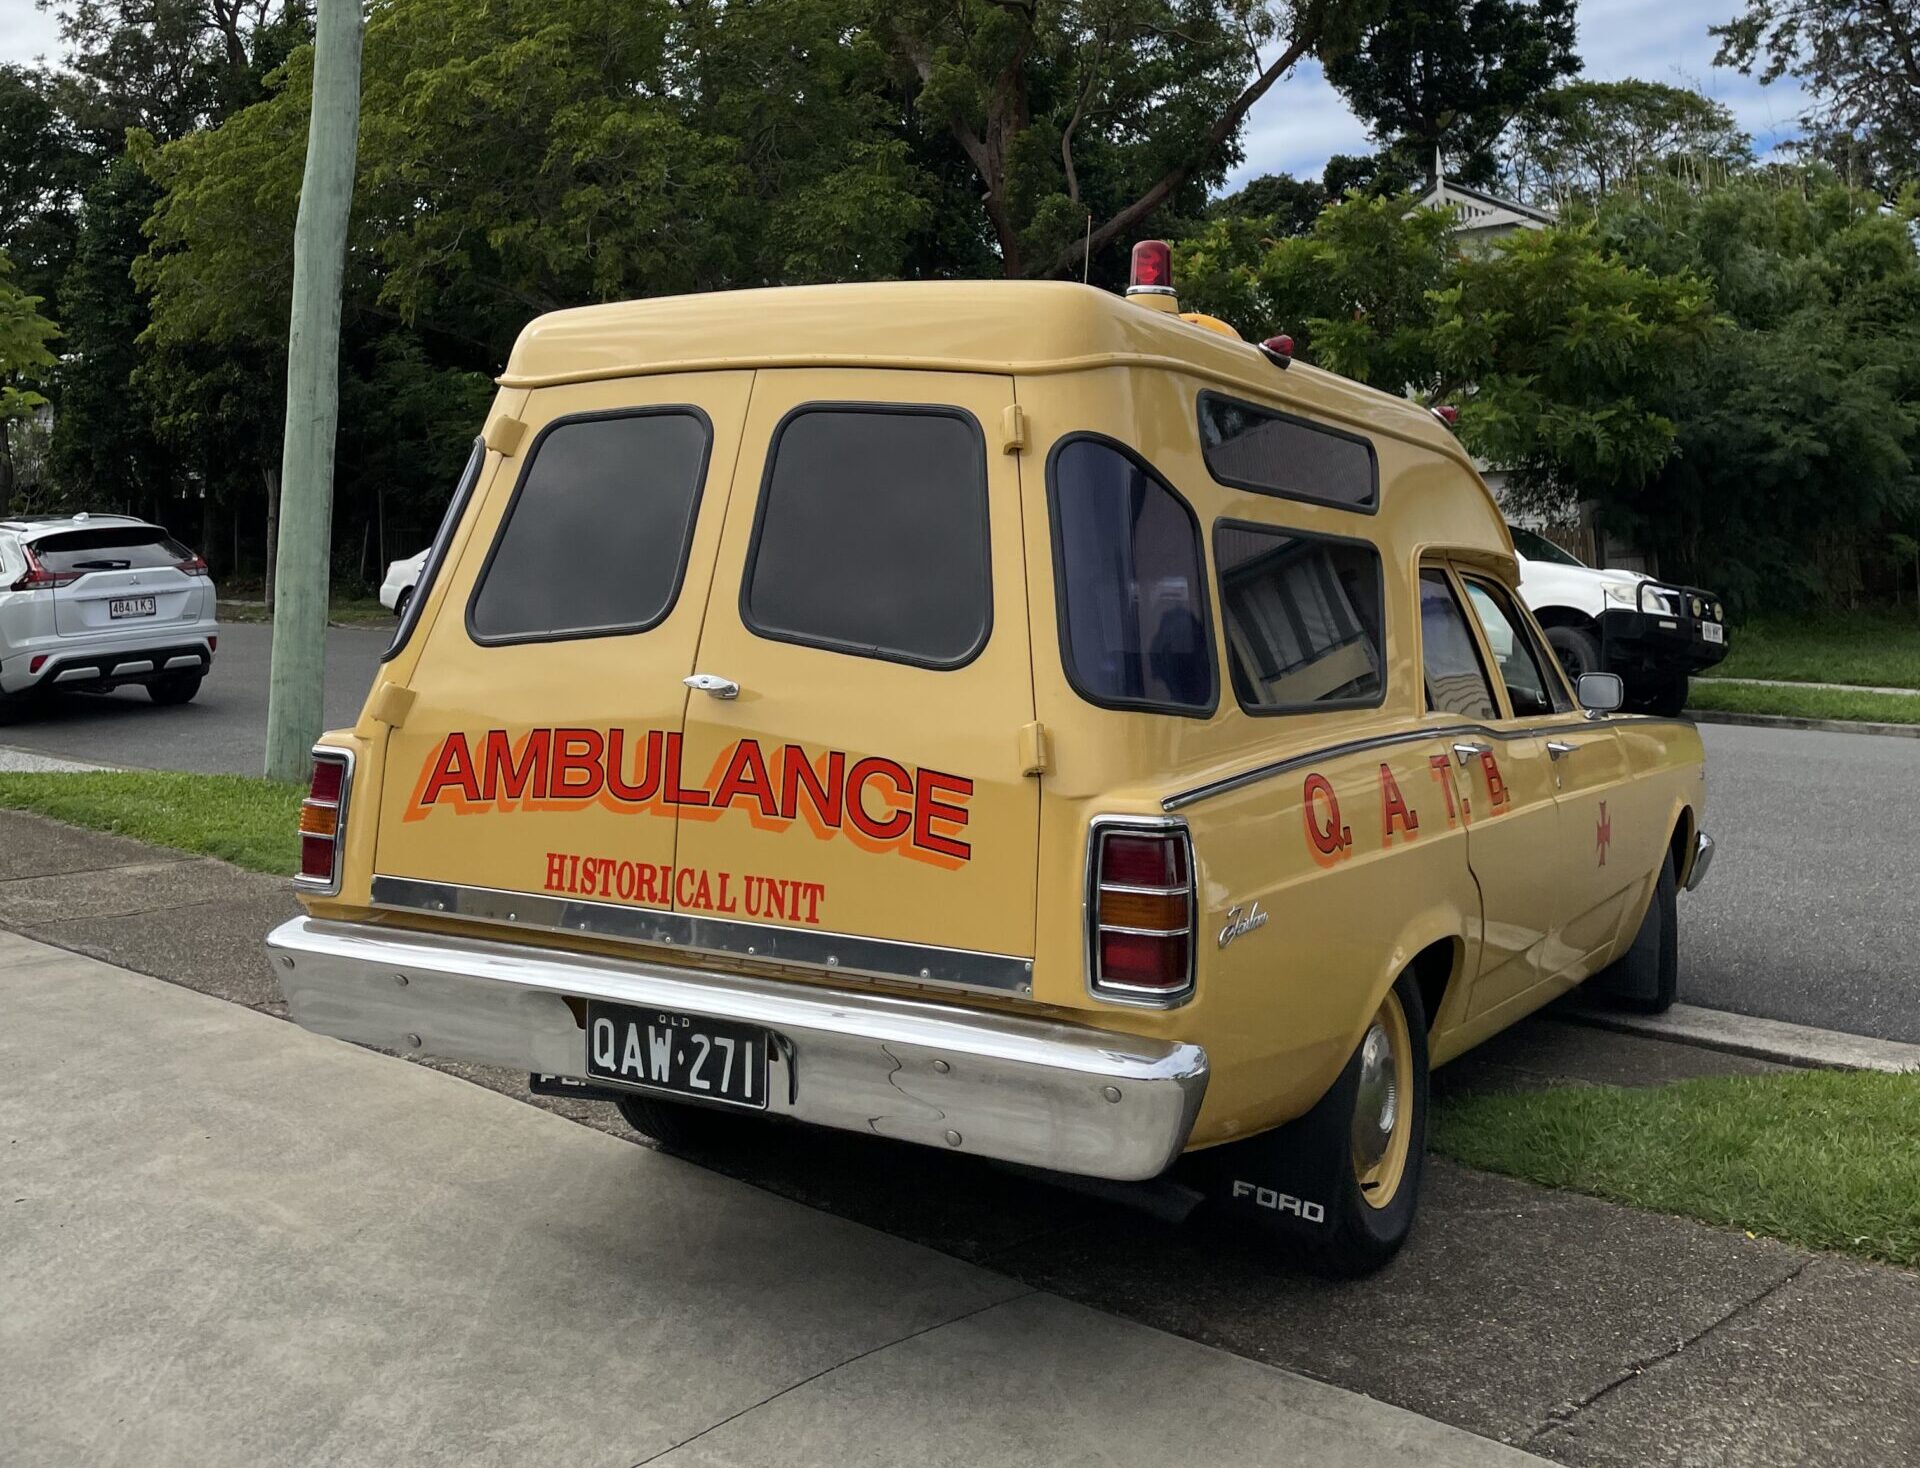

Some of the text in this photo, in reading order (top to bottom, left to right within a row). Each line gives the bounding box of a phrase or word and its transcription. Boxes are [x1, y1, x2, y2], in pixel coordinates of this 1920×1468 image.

[410, 728, 975, 865] AMBULANCE
[544, 853, 825, 923] HISTORICAL UNIT
[658, 1014, 690, 1028] QLD
[1232, 1179, 1325, 1223] FORD
